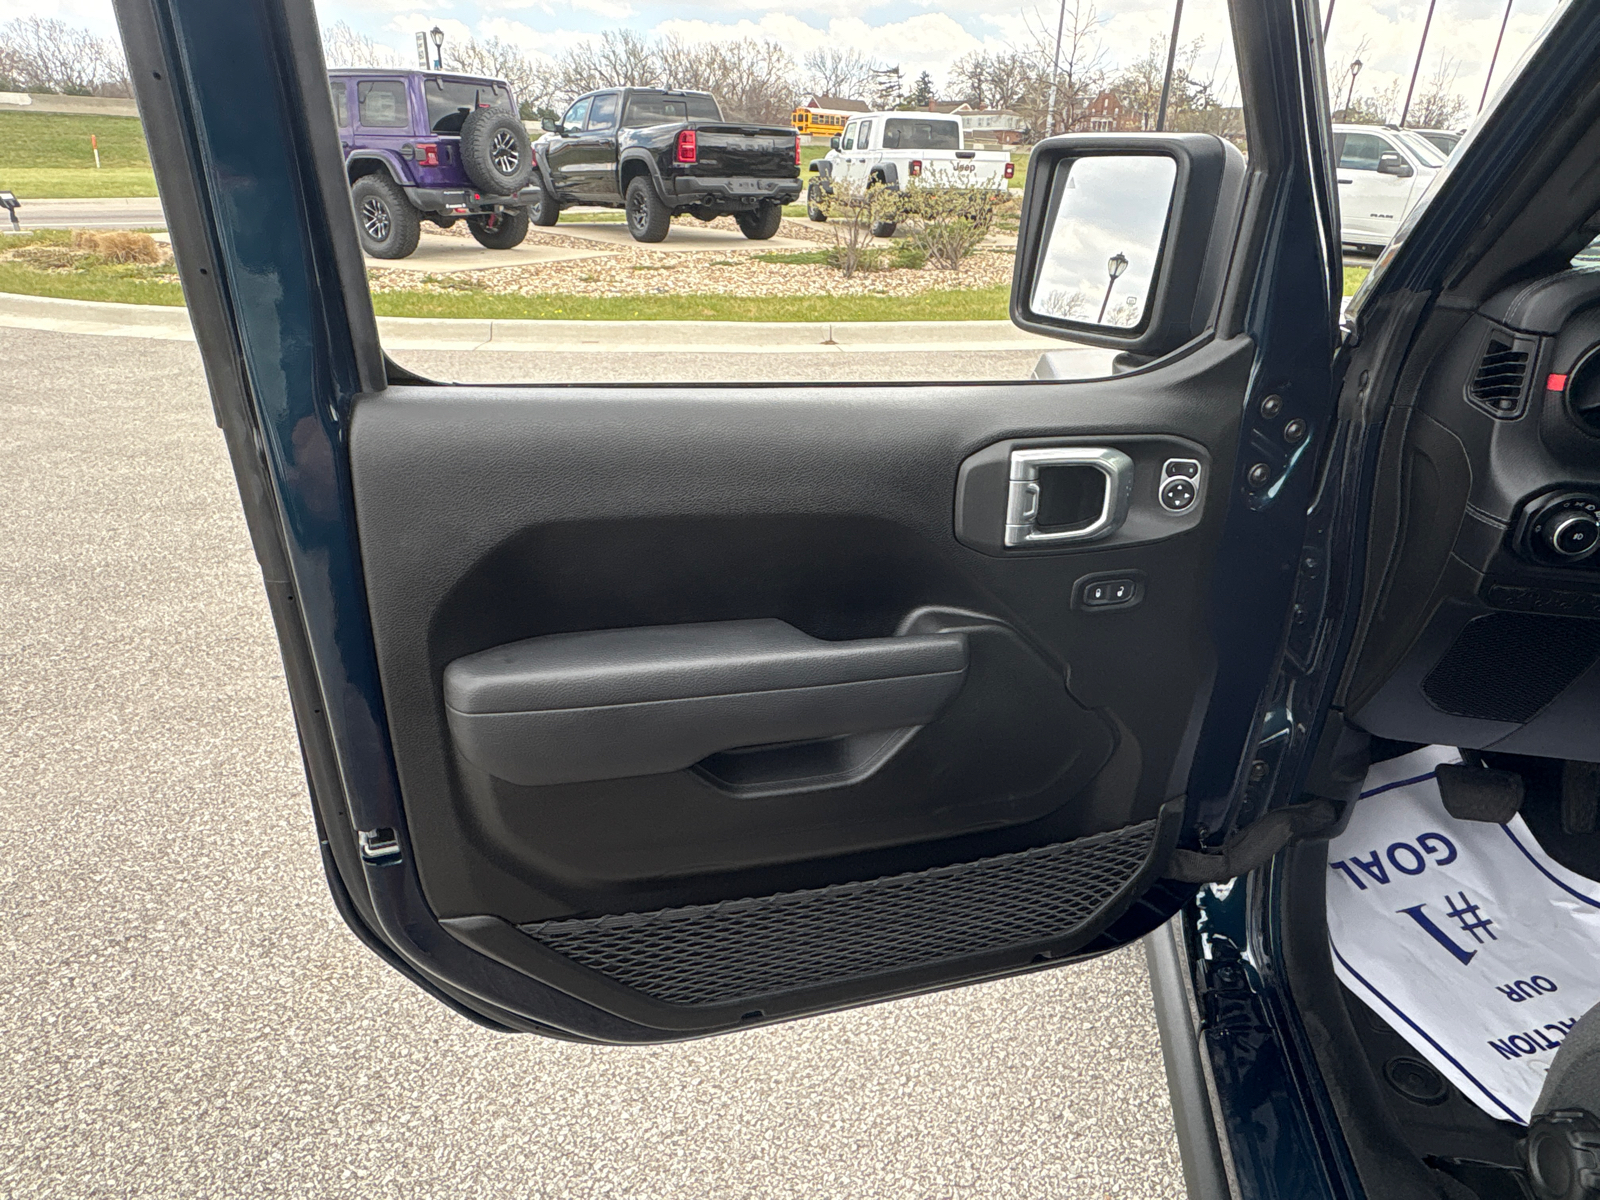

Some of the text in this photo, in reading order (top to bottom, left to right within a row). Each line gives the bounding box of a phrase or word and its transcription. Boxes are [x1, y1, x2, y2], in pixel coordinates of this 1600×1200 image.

[953, 162, 975, 173] Jeep
[1329, 832, 1458, 890] GOAL
[1395, 891, 1498, 966] #1
[1495, 975, 1558, 1003] OUR
